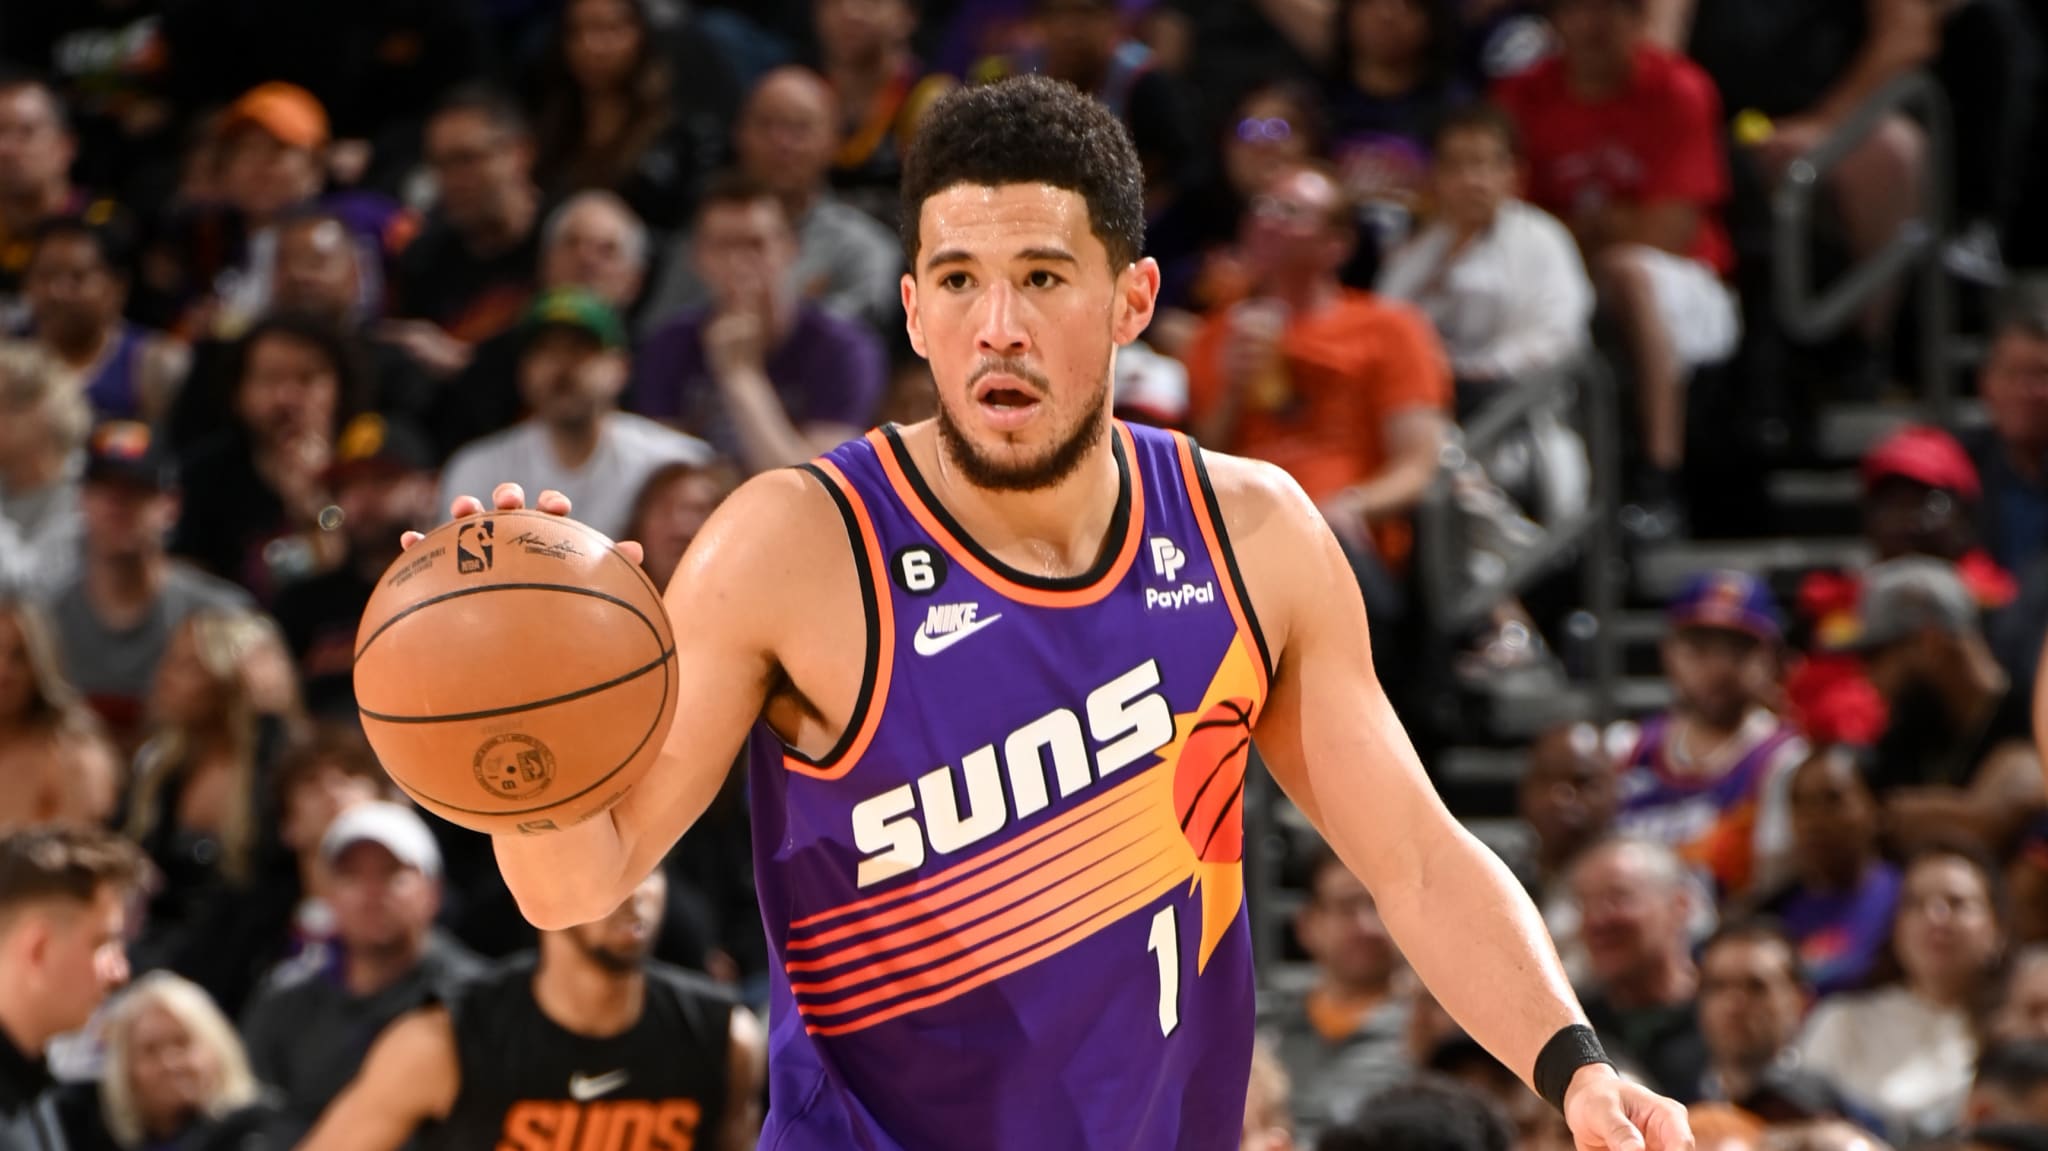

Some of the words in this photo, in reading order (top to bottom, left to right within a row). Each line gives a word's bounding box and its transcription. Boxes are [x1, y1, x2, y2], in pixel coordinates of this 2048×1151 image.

[901, 550, 935, 591] 6
[926, 602, 979, 634] NIKE
[1146, 581, 1214, 610] PayPal
[852, 658, 1176, 889] SUNS
[1148, 904, 1180, 1039] 1
[496, 1098, 701, 1151] SUNS
